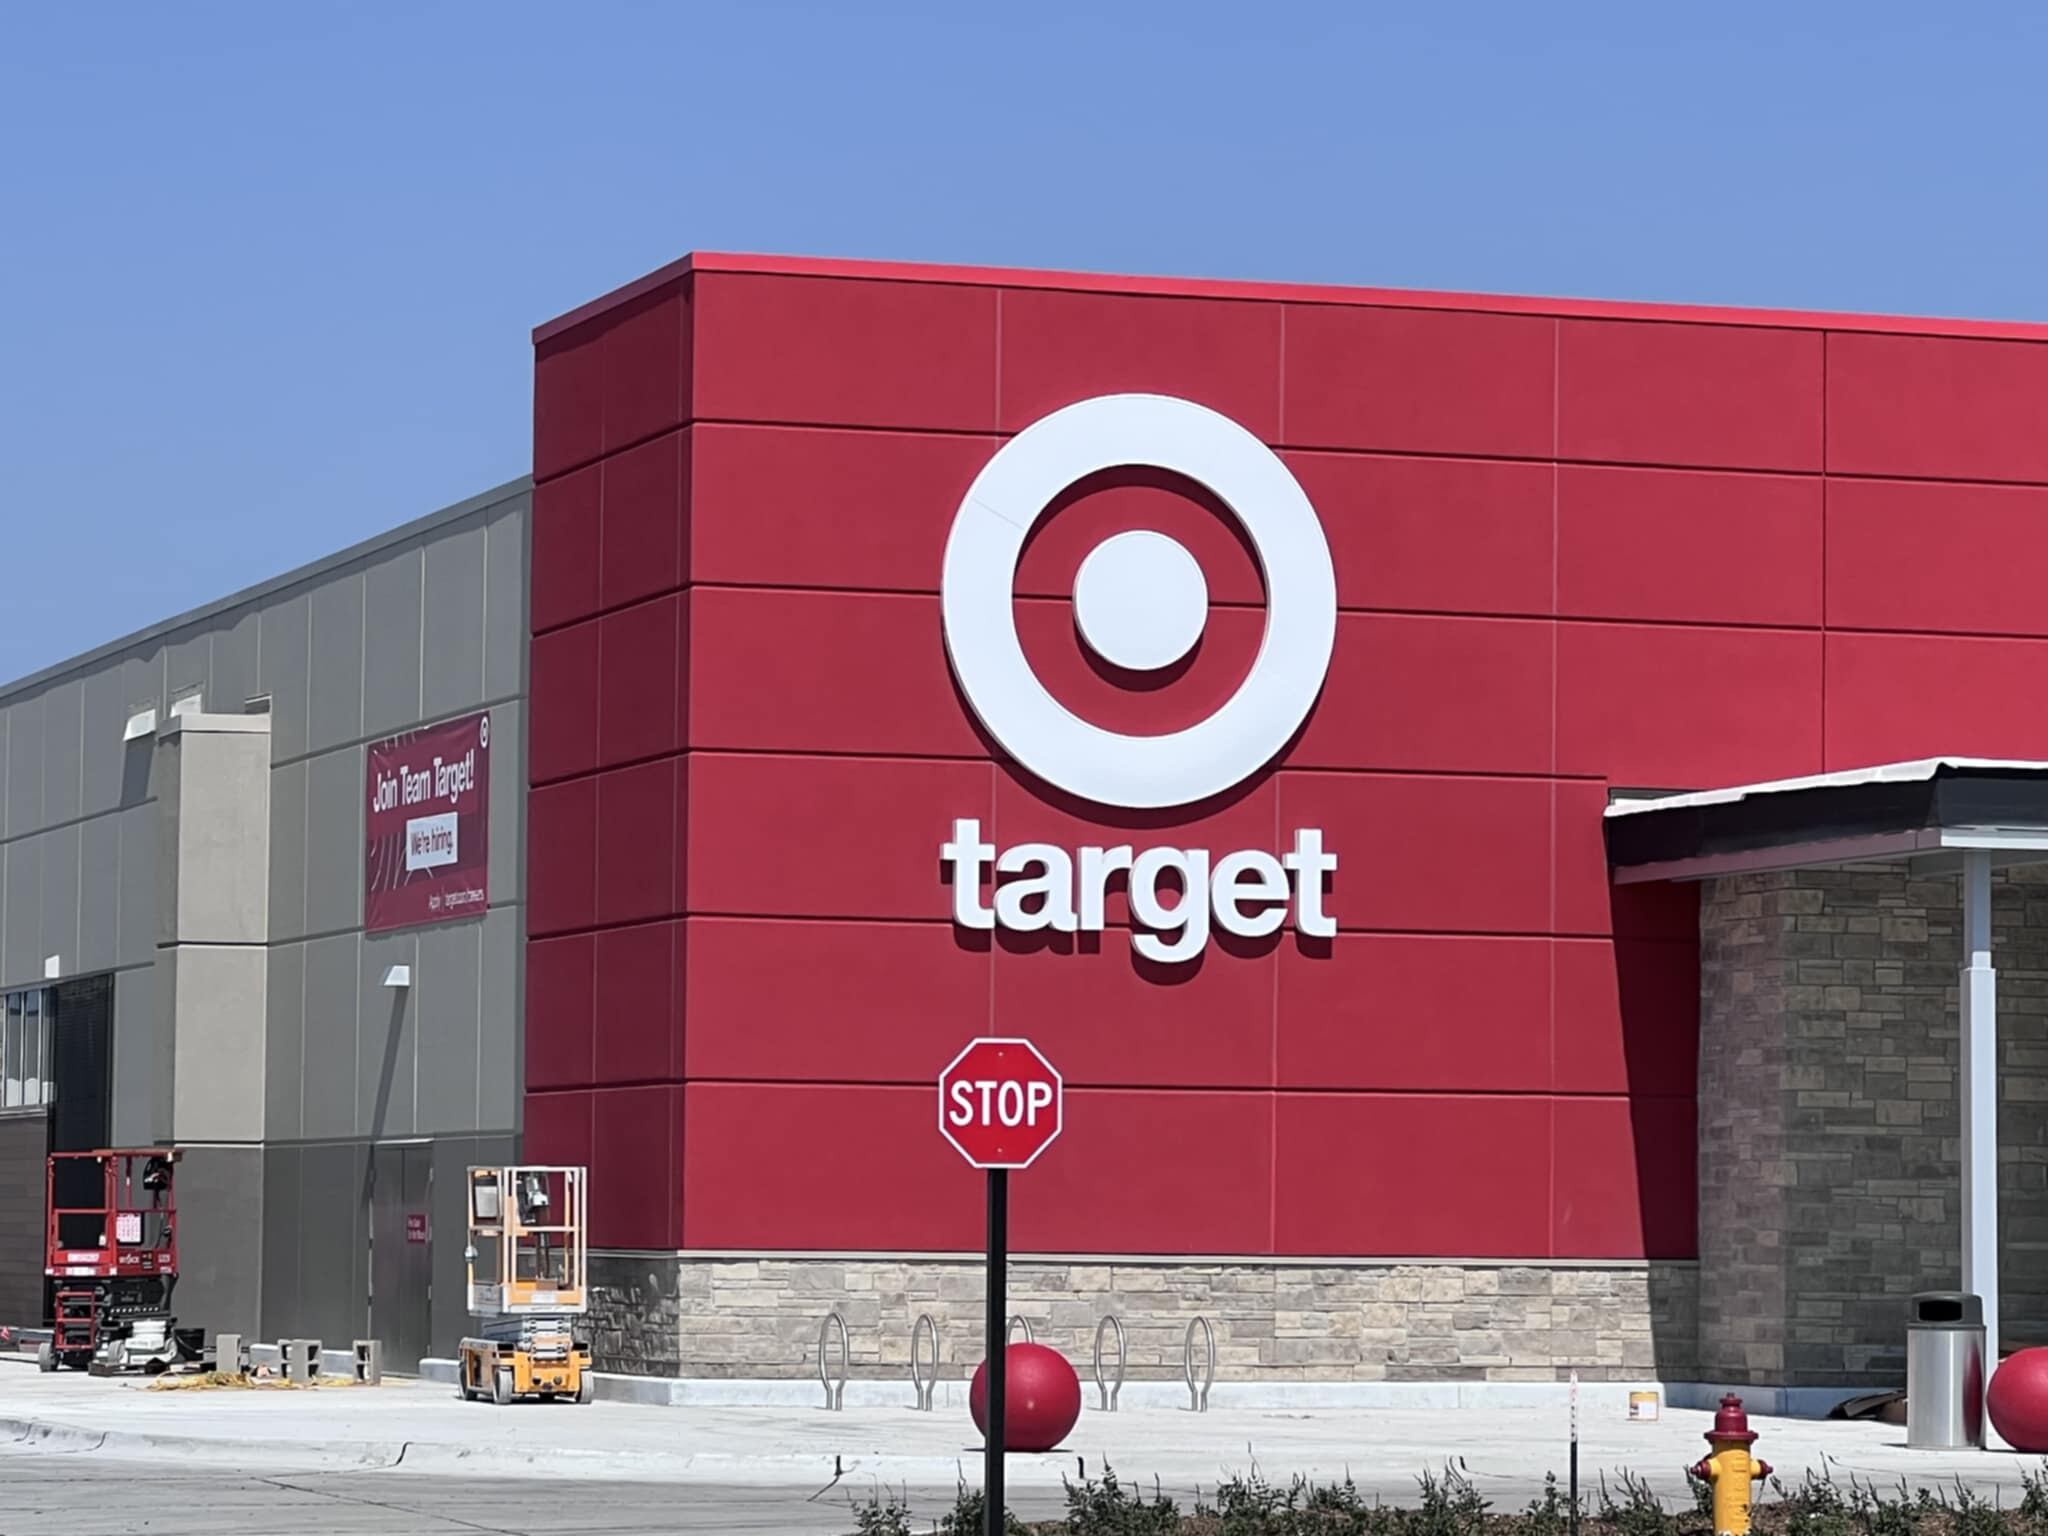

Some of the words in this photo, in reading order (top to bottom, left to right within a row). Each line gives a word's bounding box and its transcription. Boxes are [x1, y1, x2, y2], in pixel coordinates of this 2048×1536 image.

[373, 769, 398, 813] Join
[400, 765, 430, 806] Team
[433, 748, 475, 804] Target!
[940, 818, 1338, 963] target
[949, 1080, 1053, 1127] STOP
